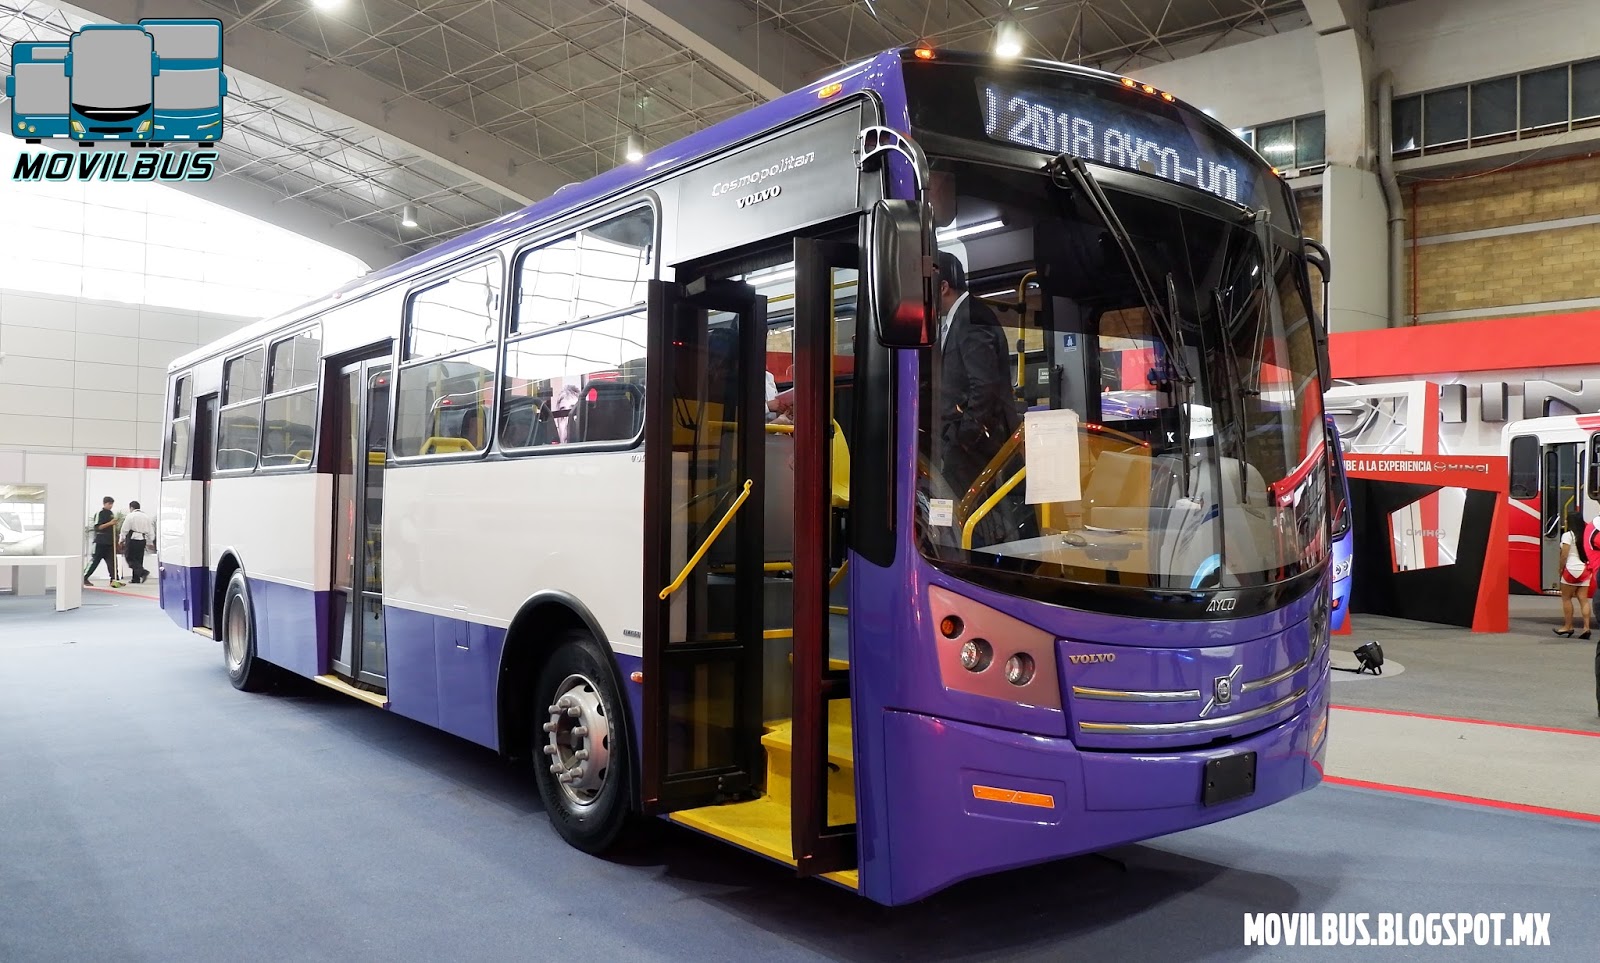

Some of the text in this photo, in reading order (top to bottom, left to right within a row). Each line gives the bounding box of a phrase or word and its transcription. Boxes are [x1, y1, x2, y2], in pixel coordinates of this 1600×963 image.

[711, 151, 815, 197] Cosmopolitan
[736, 185, 782, 209] VOLVO
[1358, 460, 1365, 471] A
[1366, 460, 1377, 471] LA
[1378, 460, 1432, 472] EXPERIENCIA
[1069, 653, 1116, 665] VOLVO
